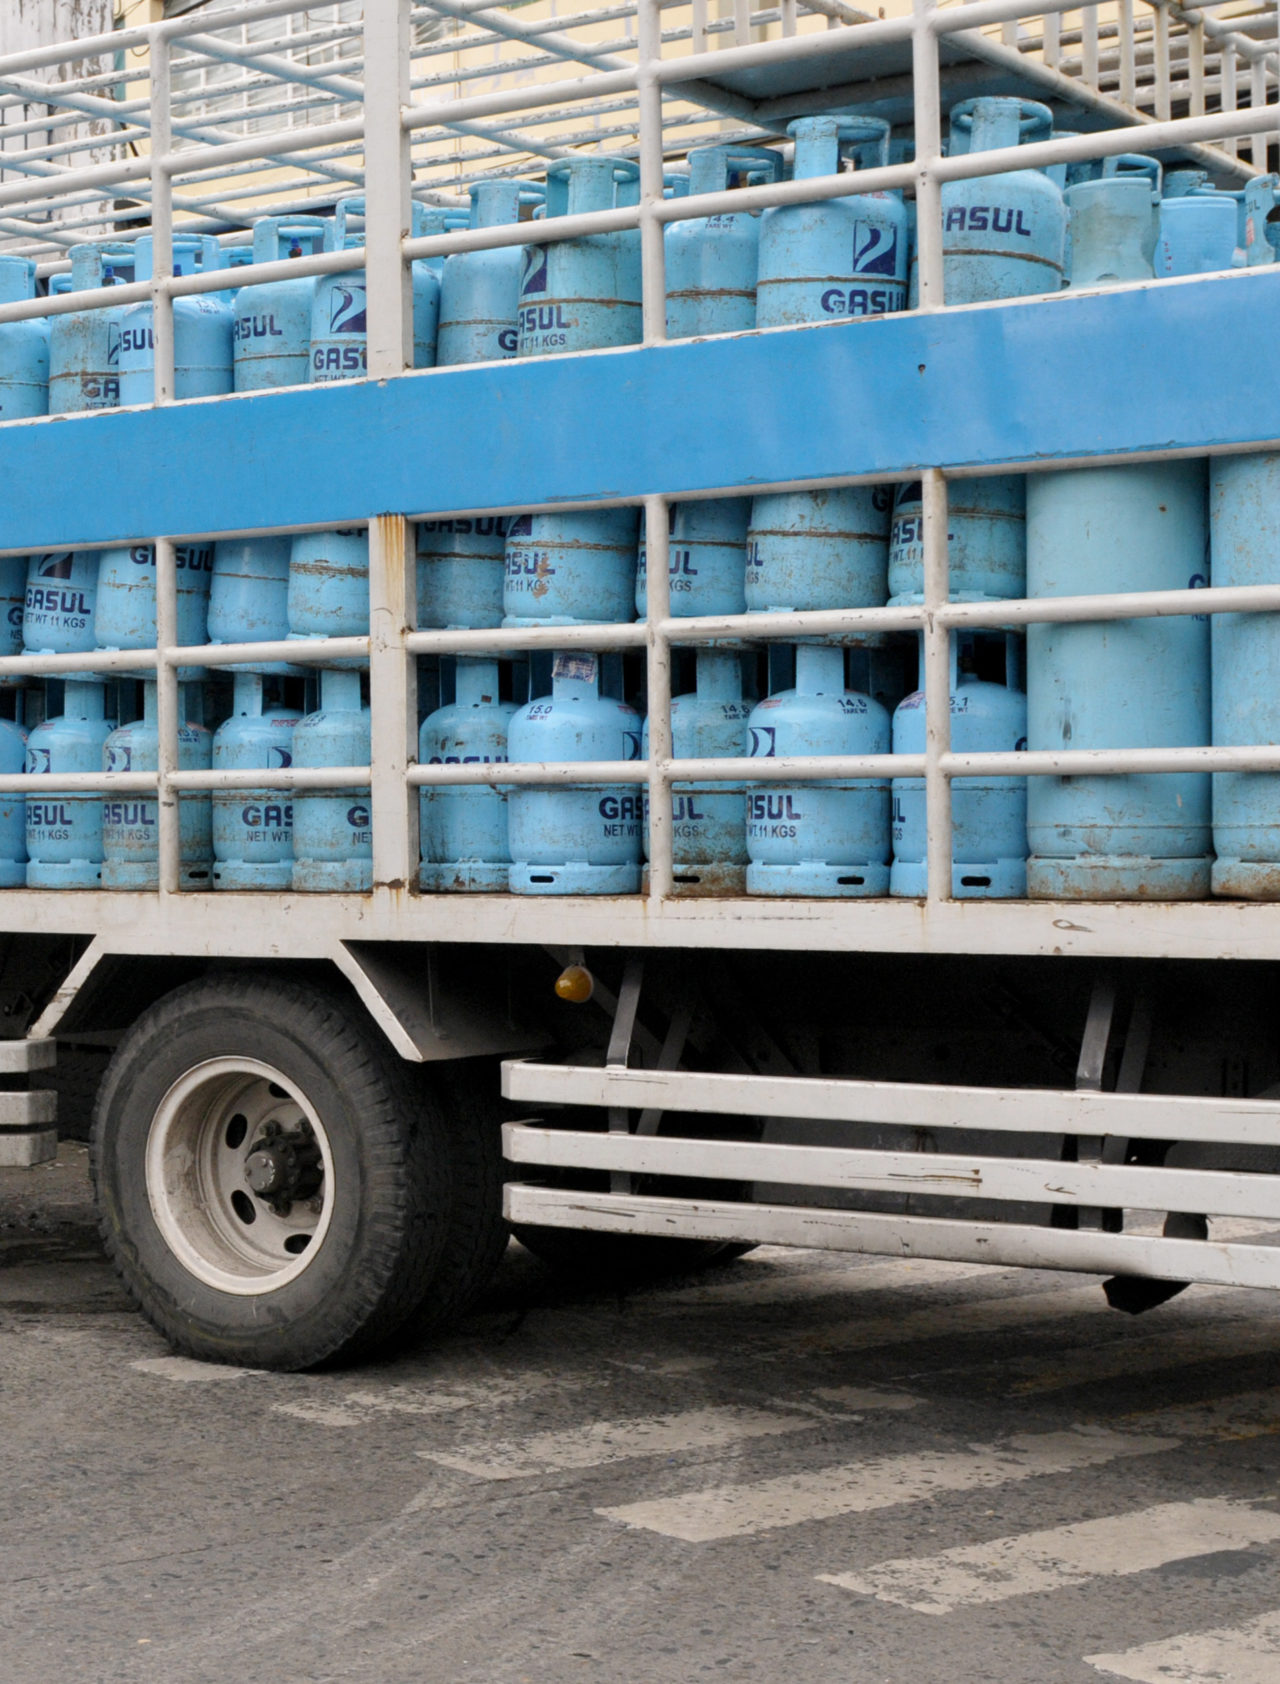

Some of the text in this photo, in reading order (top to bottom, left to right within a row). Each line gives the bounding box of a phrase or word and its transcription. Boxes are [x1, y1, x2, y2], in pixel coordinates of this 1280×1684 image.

[942, 206, 1031, 237] ASUL
[234, 314, 282, 342] ASUL
[520, 305, 571, 333] ASUL
[542, 333, 566, 346] KGS
[314, 347, 367, 371] GAS
[505, 551, 556, 576] ASUL
[63, 617, 86, 629] KGS
[948, 696, 968, 707] 5.1
[27, 805, 73, 825] ASUL
[104, 803, 154, 826] ASUL
[242, 805, 293, 828] GAS
[599, 796, 643, 820] GAS
[747, 795, 801, 821] SUL
[49, 829, 69, 841] KGS
[128, 829, 150, 841] KGS
[246, 831, 267, 842] NET
[604, 825, 624, 838] NET
[771, 825, 797, 838] KGS
